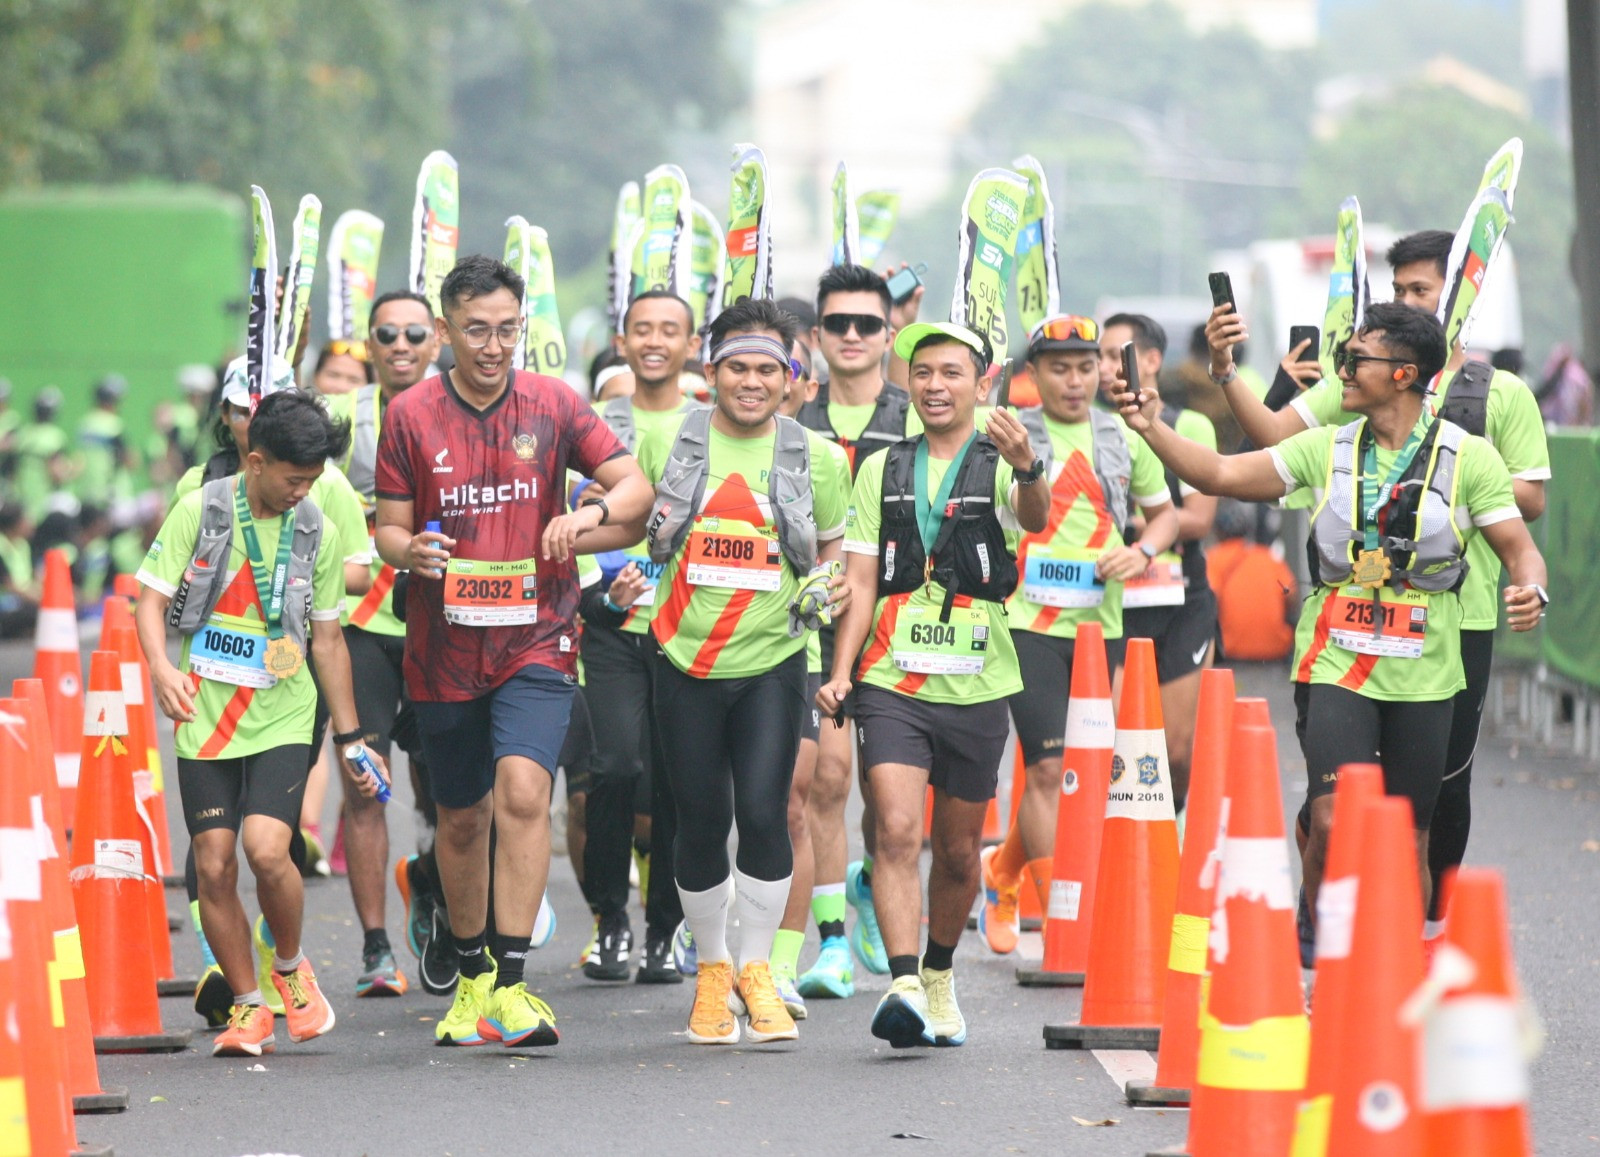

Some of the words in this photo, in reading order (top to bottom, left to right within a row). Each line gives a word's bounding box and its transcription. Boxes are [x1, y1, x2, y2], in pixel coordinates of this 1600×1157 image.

[440, 477, 537, 507] Hitachi
[472, 505, 503, 515] WIRE
[702, 536, 754, 560] 21308
[511, 563, 528, 571] M40
[885, 549, 895, 580] STRIVE
[978, 545, 989, 576] STRIVE
[1039, 562, 1081, 583] 10601
[273, 564, 287, 596] FINISHER
[456, 578, 512, 599] 23032
[171, 582, 190, 627] STRIVE
[1407, 593, 1421, 601] HM
[204, 629, 256, 659] 10603
[910, 623, 956, 647] 6304
[1137, 793, 1164, 802] 2018
